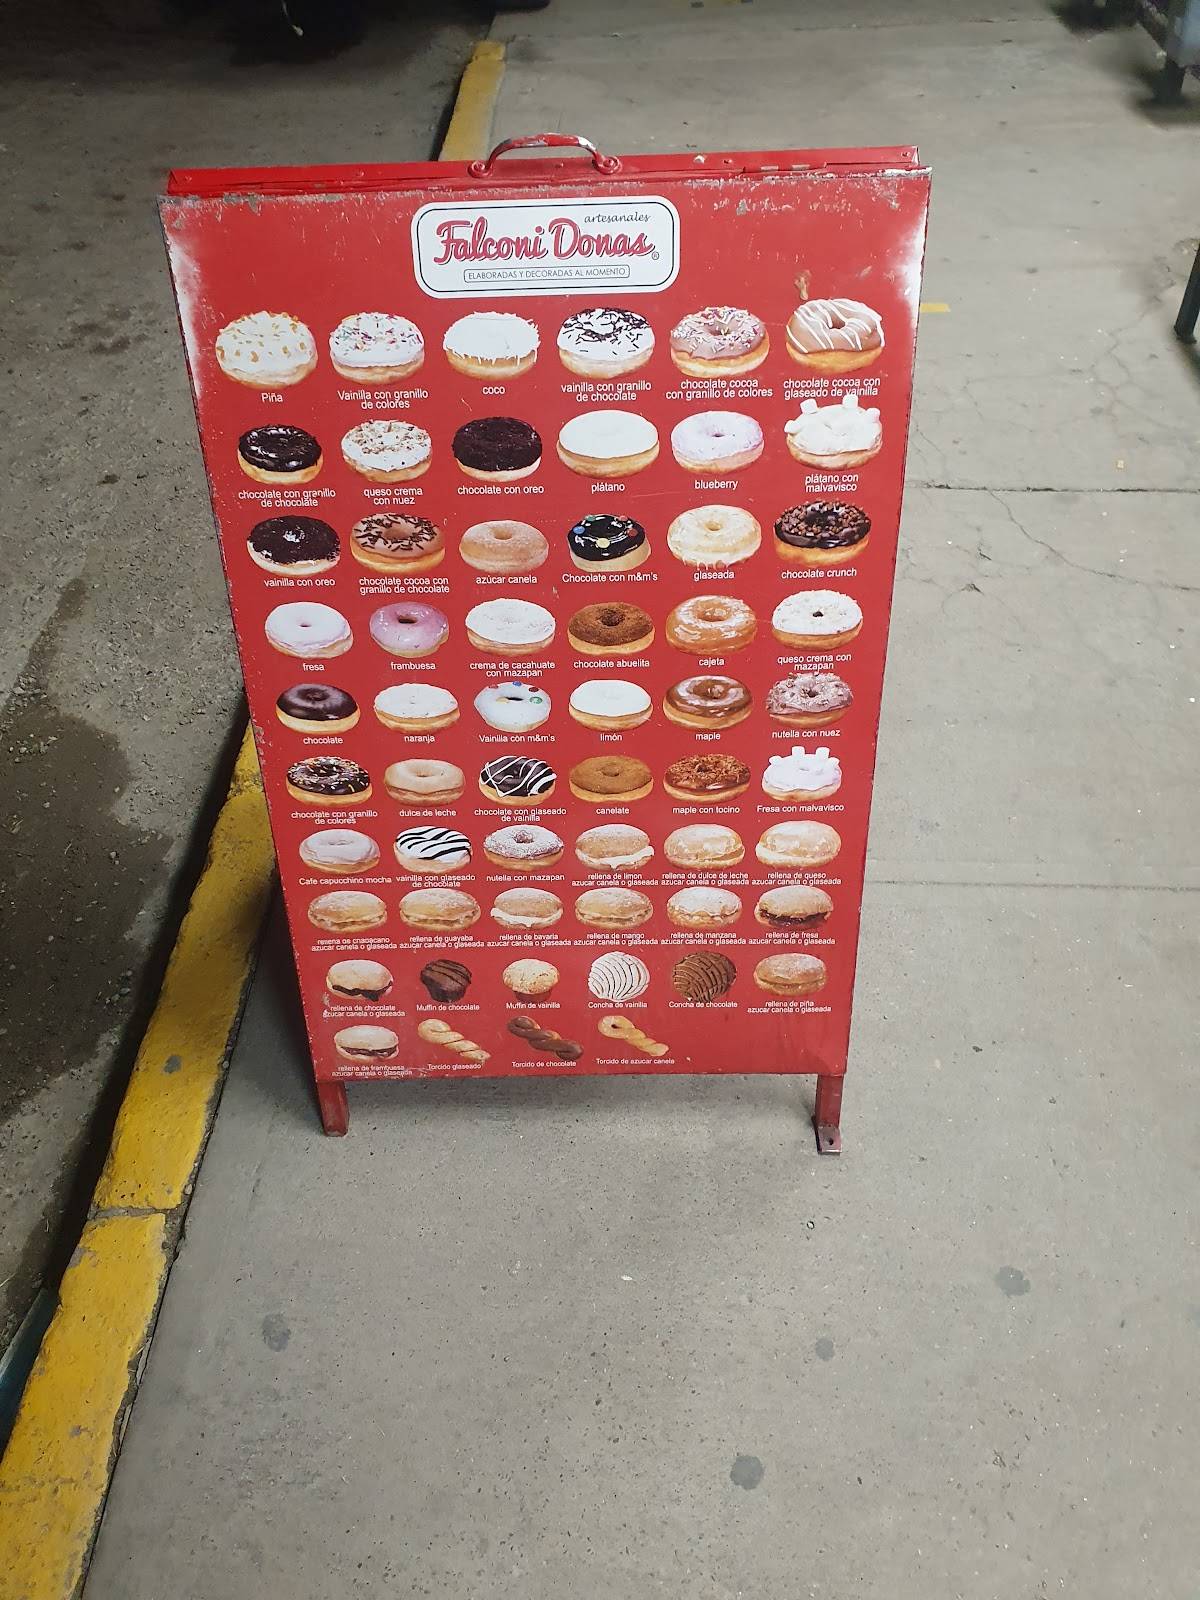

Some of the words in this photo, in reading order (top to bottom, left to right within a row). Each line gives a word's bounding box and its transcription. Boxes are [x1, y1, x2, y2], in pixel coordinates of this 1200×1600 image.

[584, 212, 650, 224] artesanales
[434, 216, 548, 265] Falconi
[468, 270, 517, 280] ELABORADAS
[519, 270, 524, 279] Y
[526, 269, 572, 278] DECORADAS
[575, 268, 584, 277] AL
[586, 267, 625, 276] MOMENTO
[561, 381, 593, 393] vainilla
[596, 383, 613, 392] con
[616, 380, 652, 394] granillo
[681, 377, 726, 388] chocolate
[729, 379, 758, 387] cocoa
[784, 377, 829, 388] chocolate
[831, 379, 860, 387] cocoa
[862, 378, 880, 386] con
[338, 390, 371, 401] Vainilla
[374, 392, 391, 400] con
[393, 388, 428, 402] granillo
[482, 387, 505, 395] coco
[576, 392, 588, 402] de
[590, 390, 636, 402] chocolate
[685, 388, 720, 400] granillo
[722, 387, 735, 398] de
[738, 387, 773, 397] colores
[784, 386, 828, 400] glaseado
[830, 386, 842, 396] de
[844, 385, 878, 396] vainilla
[262, 393, 283, 403] Piña
[361, 399, 373, 410] de
[375, 399, 410, 409] colores
[805, 472, 839, 485] plátano
[841, 474, 858, 482] con
[458, 484, 501, 495] chocolate
[503, 486, 520, 494] con
[523, 486, 544, 494] oreo
[591, 481, 625, 494] plátano
[695, 478, 738, 492] blueberry
[806, 481, 857, 492] malvavisco
[238, 488, 281, 499] chocolate
[283, 490, 300, 498] con
[301, 487, 336, 500] granillo
[364, 489, 391, 499] queso
[394, 488, 423, 496] crema
[261, 498, 272, 508] de
[274, 497, 318, 507] chocolate
[392, 497, 415, 505] nuez
[562, 573, 606, 583] Chocolate
[608, 574, 625, 582] con
[627, 572, 658, 581] m&m's
[694, 570, 734, 582] glaseada
[781, 568, 824, 578] chocolate
[826, 568, 857, 578] crunch
[264, 578, 294, 587] vainilla
[359, 576, 401, 585] chocolate
[476, 574, 505, 584] azúcar
[507, 574, 537, 583] canela
[360, 585, 391, 596] granillo
[393, 584, 405, 594] de
[407, 584, 450, 594] chocolate
[498, 660, 509, 669] de
[511, 660, 555, 669] cacahuate
[574, 658, 614, 668] chocolate
[616, 658, 650, 668] abuelita
[698, 657, 724, 668] cajeta
[777, 655, 804, 665] queso
[806, 654, 833, 662] crema
[303, 662, 324, 671] fresa
[391, 661, 436, 670] frambuesa
[479, 734, 508, 742] Vainilla
[600, 732, 622, 741] limón
[696, 732, 720, 742] maple
[772, 729, 799, 738] nutella
[303, 736, 343, 744] chocolate
[404, 734, 435, 744] naranja
[399, 808, 420, 816] dulce
[422, 808, 433, 816] de
[434, 808, 456, 816] leche
[474, 807, 512, 815] chocolate
[530, 807, 567, 816] glaseado
[596, 806, 629, 814] canelate
[673, 805, 696, 816] maple
[715, 805, 740, 813] tocino
[757, 804, 780, 812] Fresa
[799, 802, 844, 811] malvavisco
[291, 810, 329, 818] chocolate
[348, 809, 378, 819] granillo
[513, 813, 540, 821] vainilla
[315, 816, 325, 824] de
[326, 816, 356, 824] colores
[440, 874, 475, 882] glaseado
[486, 873, 511, 881] nutella
[451, 1063, 481, 1071] glaseado
